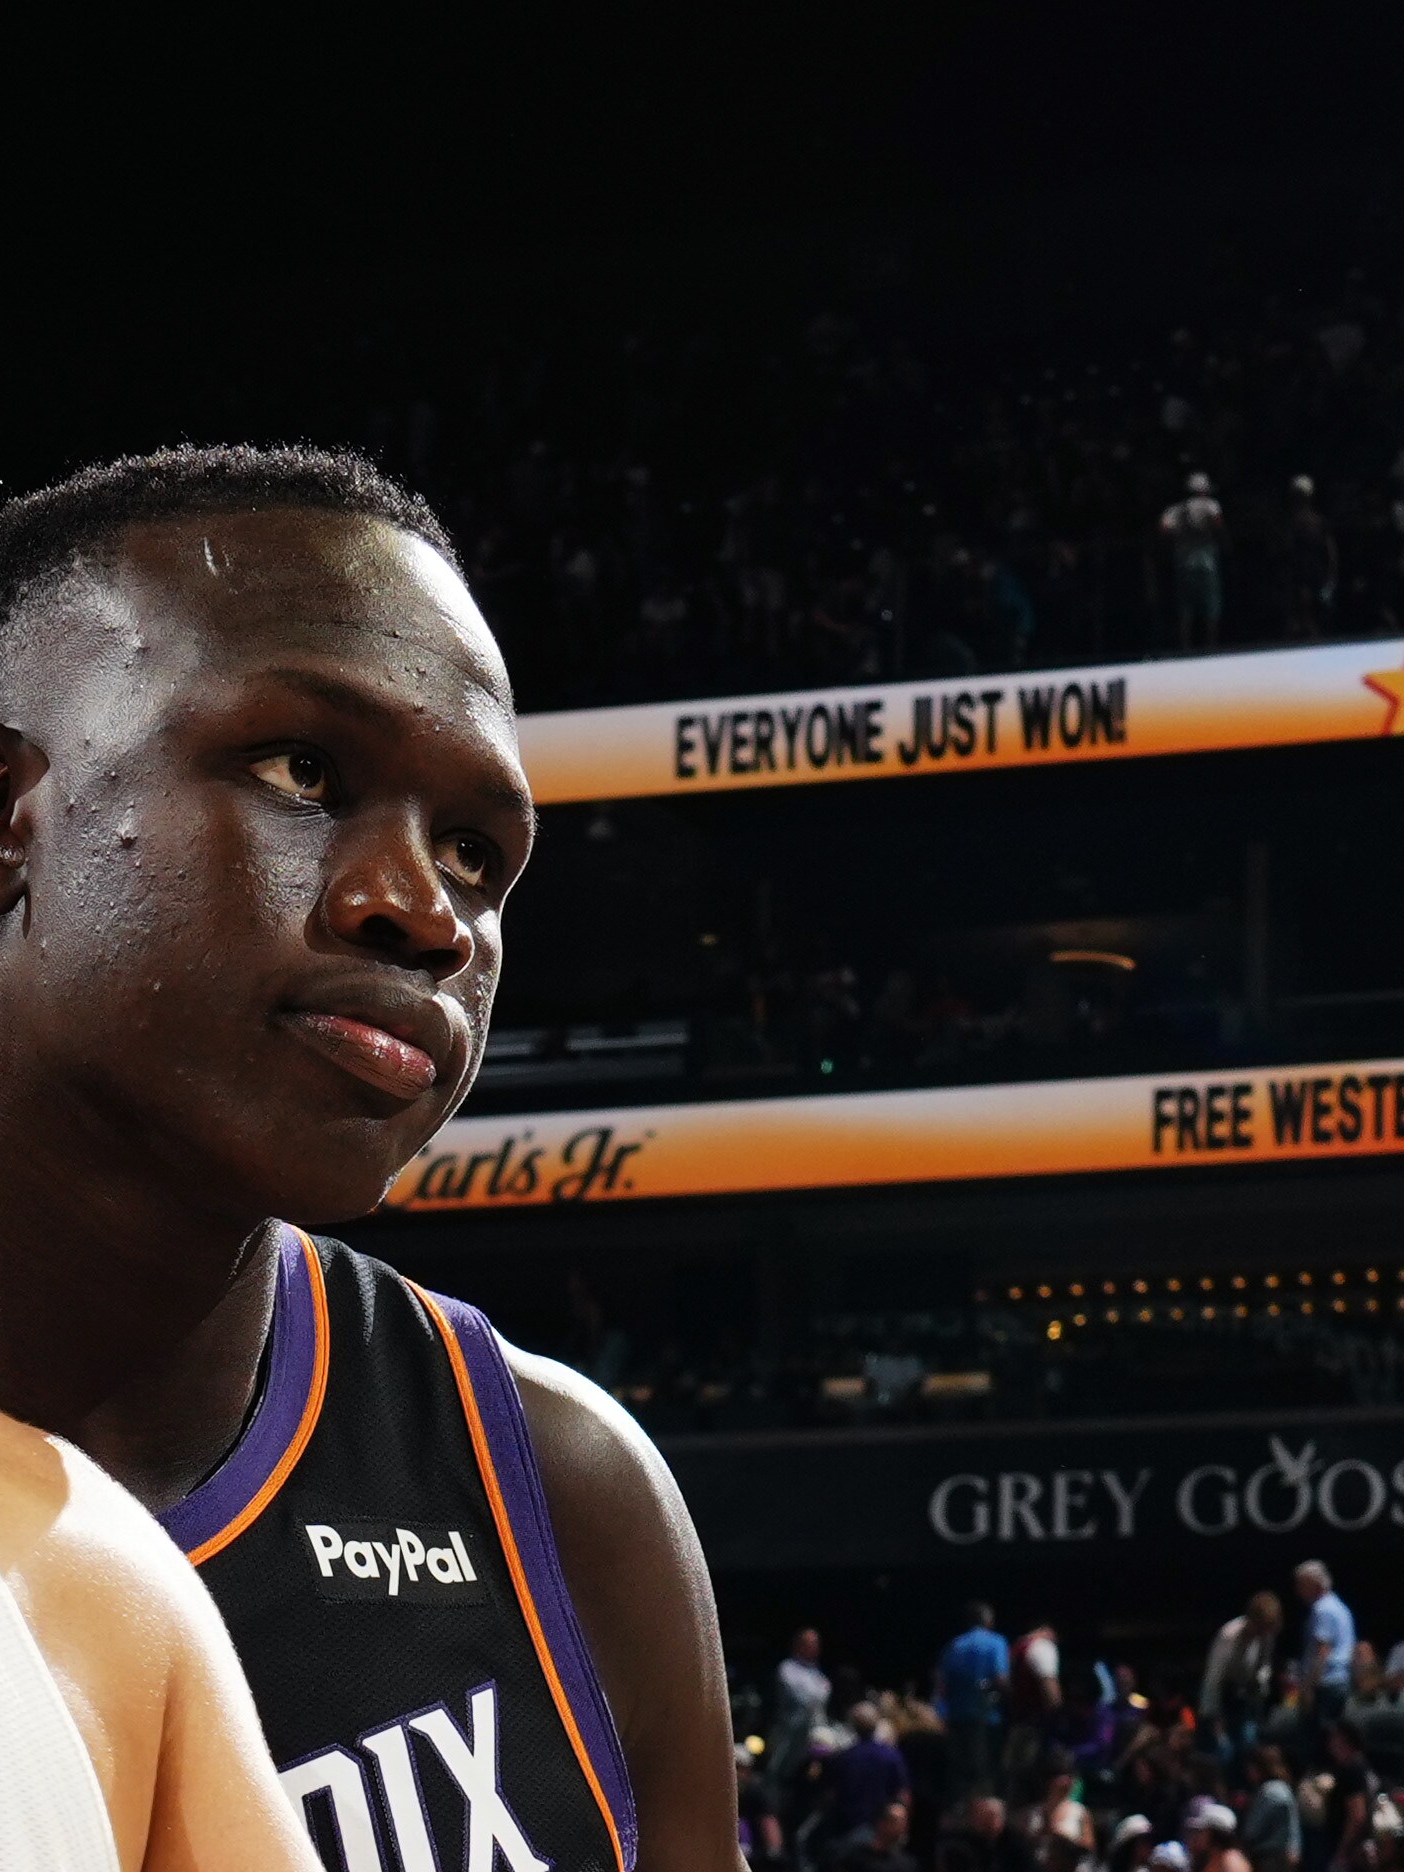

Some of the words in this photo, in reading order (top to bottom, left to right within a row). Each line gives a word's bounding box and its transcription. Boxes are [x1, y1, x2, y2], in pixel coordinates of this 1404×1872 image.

[675, 699, 884, 779] EVERYONE
[898, 689, 1003, 766] JUST
[1018, 677, 1127, 751] WON!
[1153, 1082, 1254, 1154] FREE
[411, 1127, 546, 1200] arl's
[927, 1467, 1154, 1546] GREY
[305, 1524, 478, 1597] PayPal
